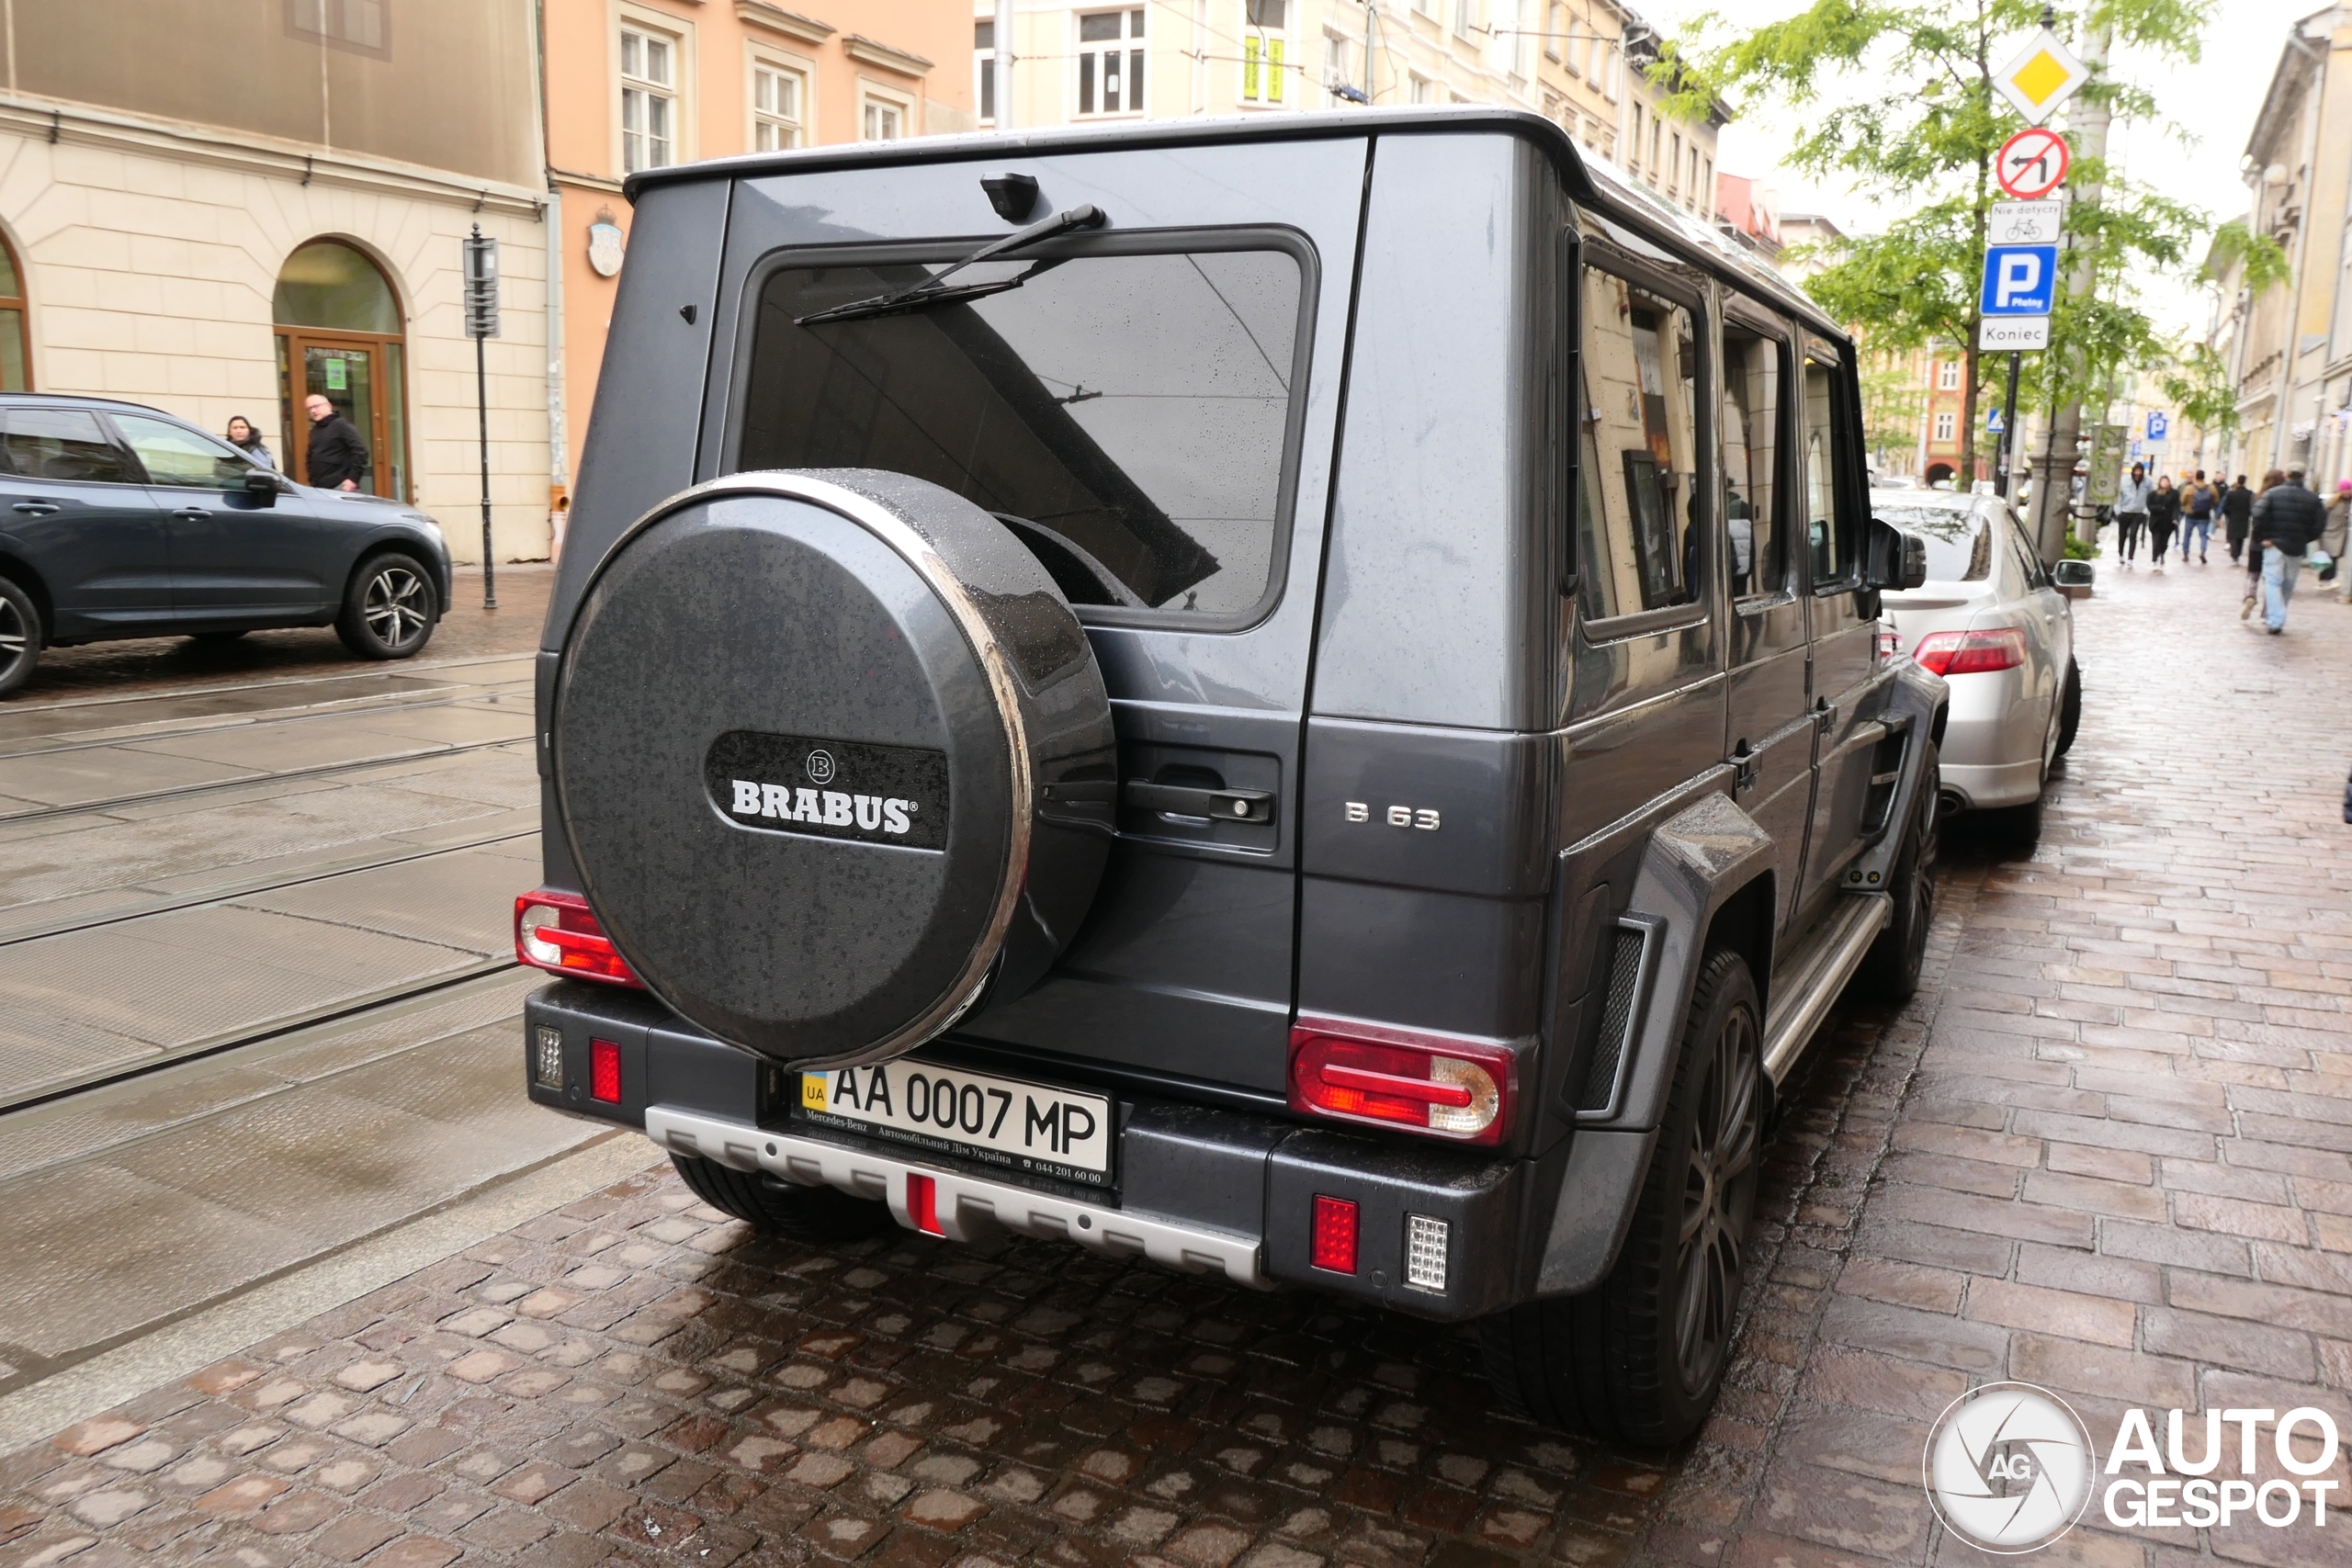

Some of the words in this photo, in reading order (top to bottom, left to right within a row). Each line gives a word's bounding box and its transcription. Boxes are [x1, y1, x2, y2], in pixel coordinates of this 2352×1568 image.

[1994, 206, 2013, 215] Nie
[2018, 205, 2058, 217] dotyczy
[1996, 254, 2041, 307] P
[1985, 327, 2041, 341] Koniec
[1386, 805, 1441, 831] 63
[807, 1086, 825, 1102] UA
[806, 1109, 868, 1133] Mercedes-Benz
[832, 1066, 893, 1117] AA
[906, 1073, 1013, 1139] 0007
[1024, 1094, 1096, 1155] MP
[878, 1126, 950, 1151] Автомобільний
[952, 1142, 970, 1156] Дім
[972, 1146, 1012, 1165] Україна
[1035, 1162, 1053, 1174] 044
[1056, 1166, 1071, 1178] 201
[1074, 1170, 1087, 1180] 60
[1089, 1173, 1101, 1183] 00
